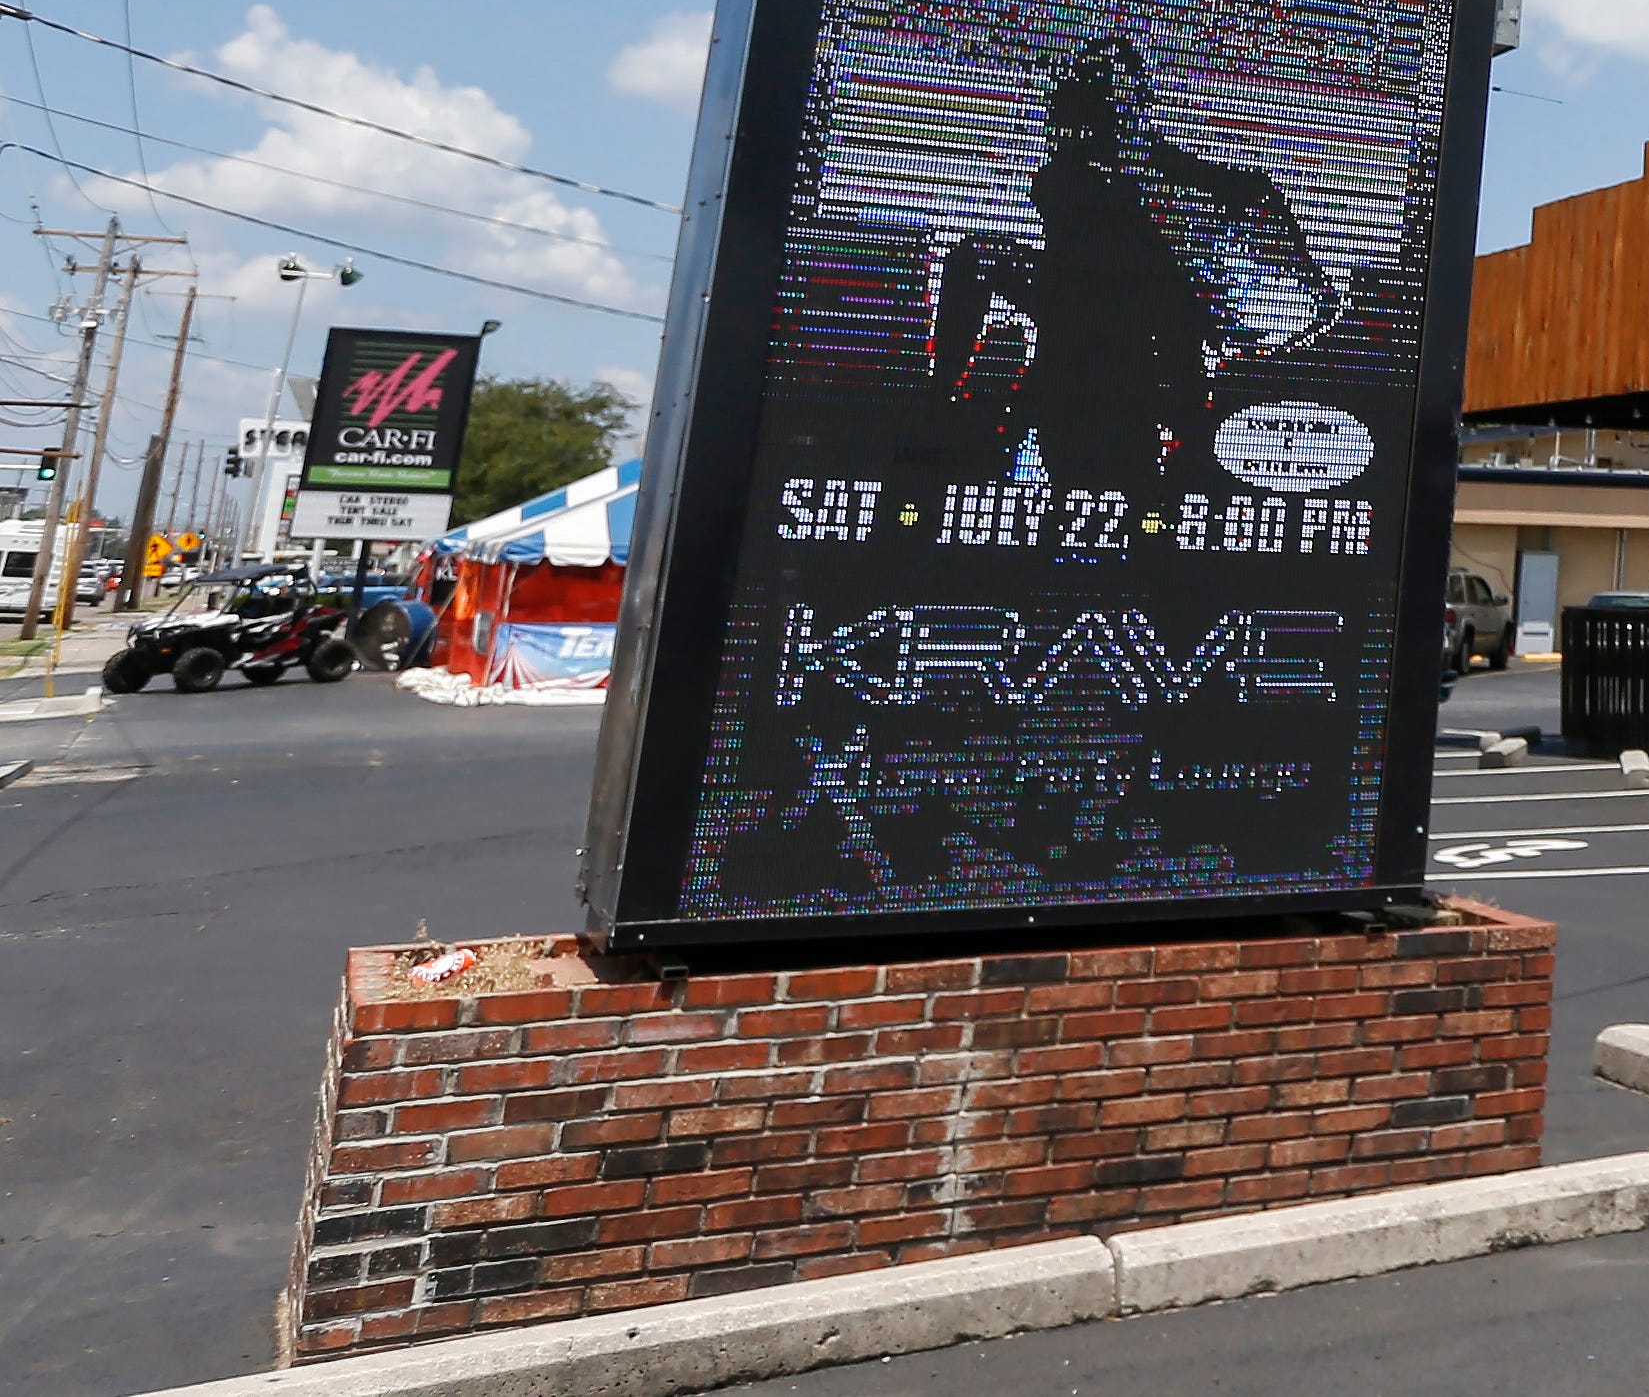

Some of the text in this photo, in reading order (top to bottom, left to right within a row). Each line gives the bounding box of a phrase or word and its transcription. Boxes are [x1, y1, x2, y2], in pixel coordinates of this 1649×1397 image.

[778, 479, 882, 541] SAT
[1061, 489, 1128, 548] 22
[1300, 498, 1373, 554] PM
[776, 604, 1343, 704] KRAVE
